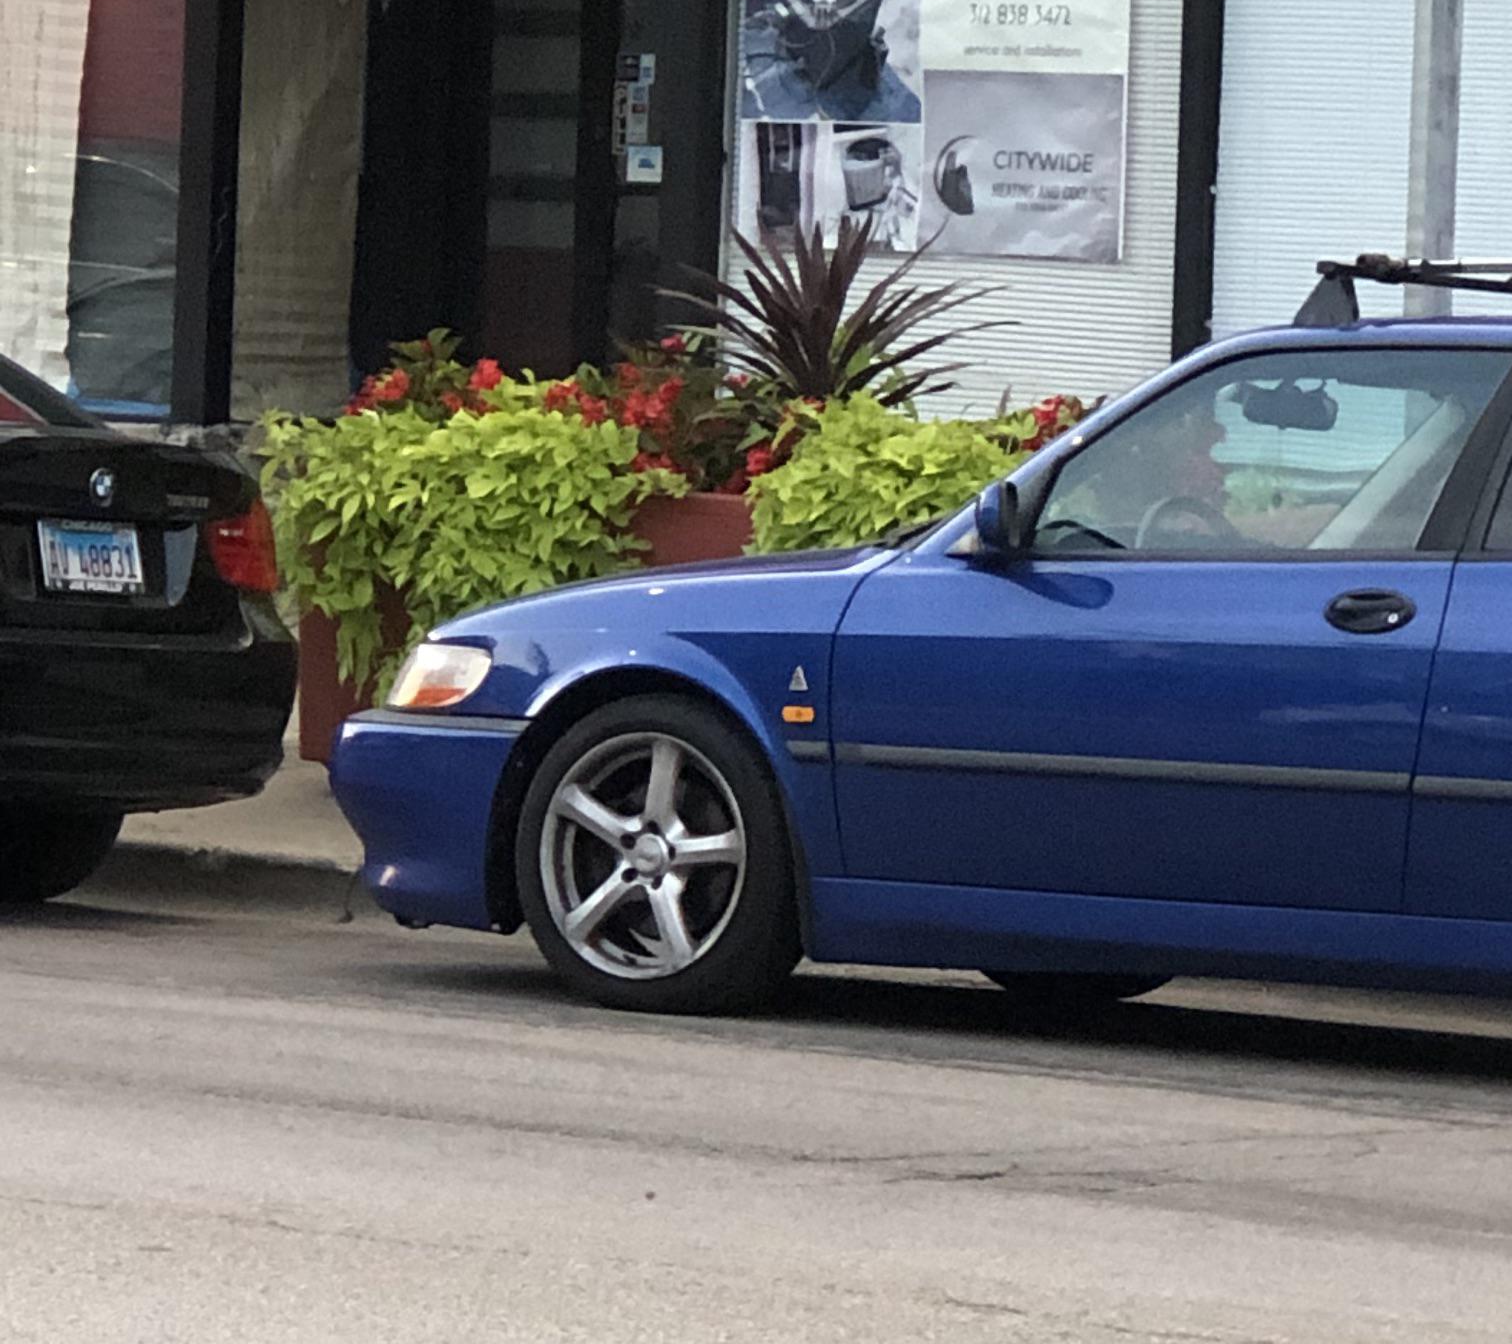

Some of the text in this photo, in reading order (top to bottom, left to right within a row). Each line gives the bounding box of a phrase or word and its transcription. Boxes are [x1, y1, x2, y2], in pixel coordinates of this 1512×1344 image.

[969, 3, 1073, 26] 312 838 3472
[992, 150, 1095, 173] CITYWIDE
